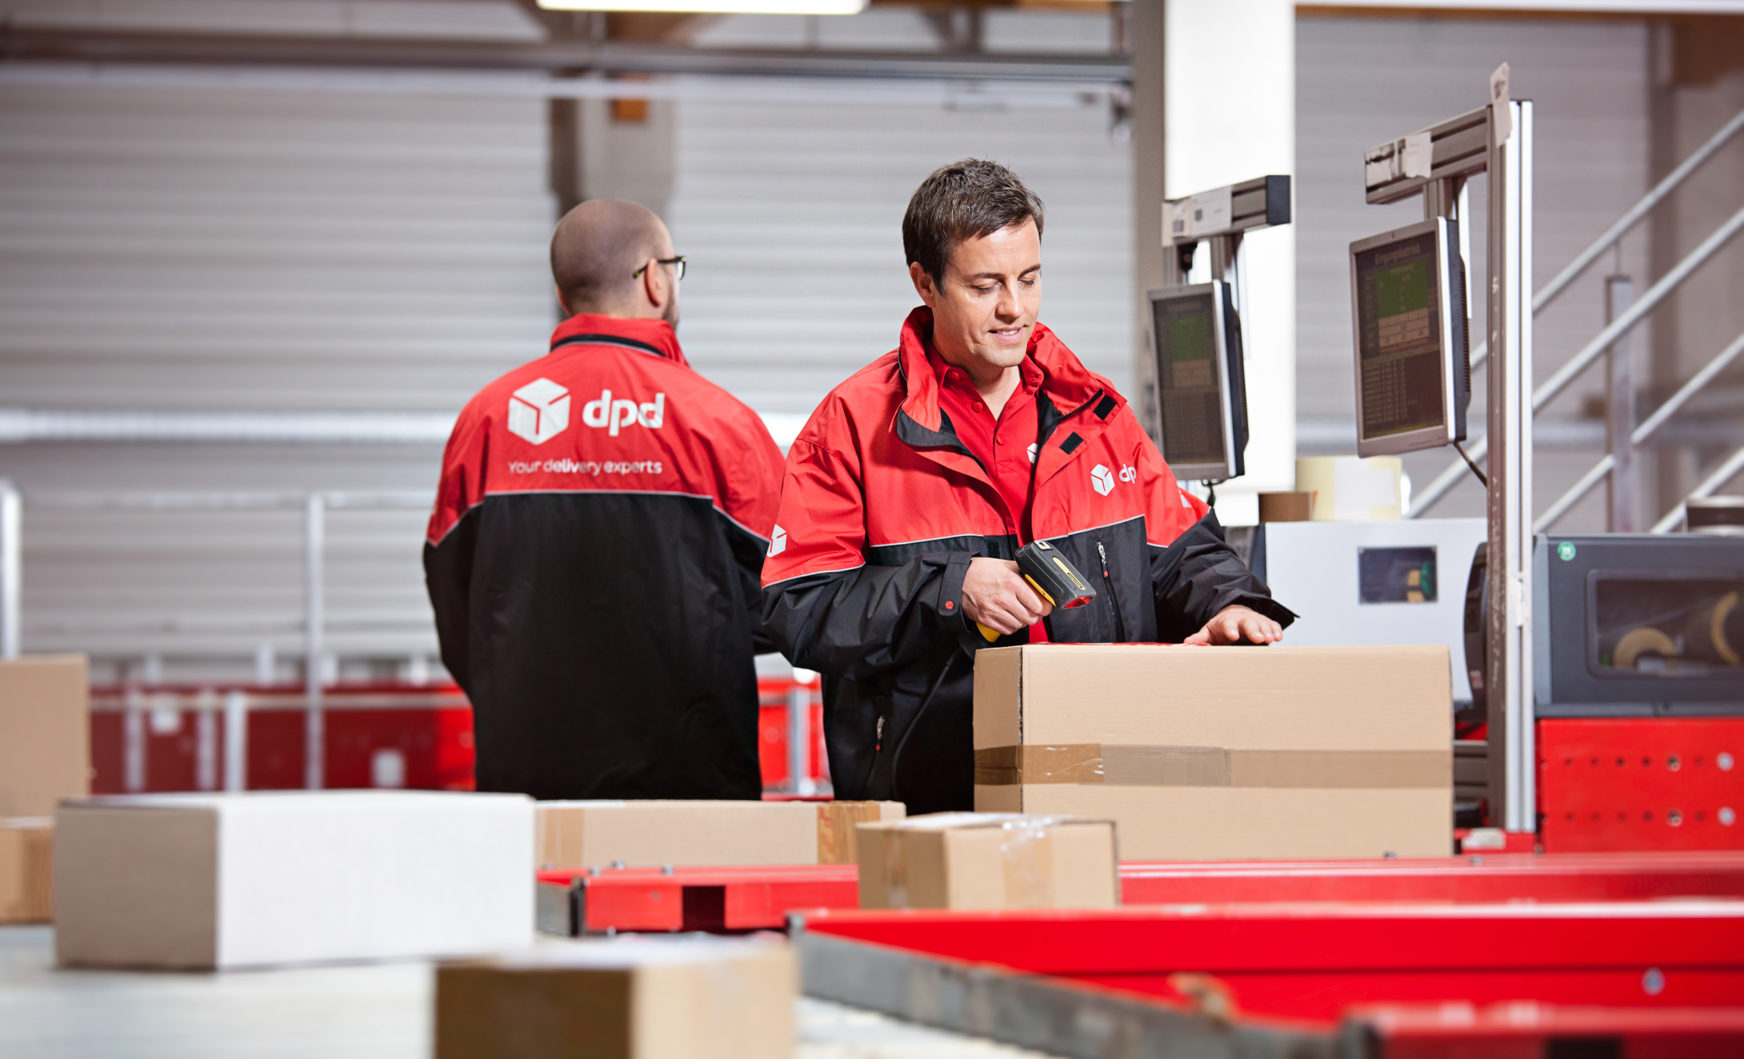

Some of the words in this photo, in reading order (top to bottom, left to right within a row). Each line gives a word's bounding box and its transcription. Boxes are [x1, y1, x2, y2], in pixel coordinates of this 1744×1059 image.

[582, 389, 665, 436] dpd
[508, 461, 541, 474] Your
[543, 459, 601, 476] delivery
[603, 461, 662, 476] experts
[1119, 464, 1136, 484] dp
